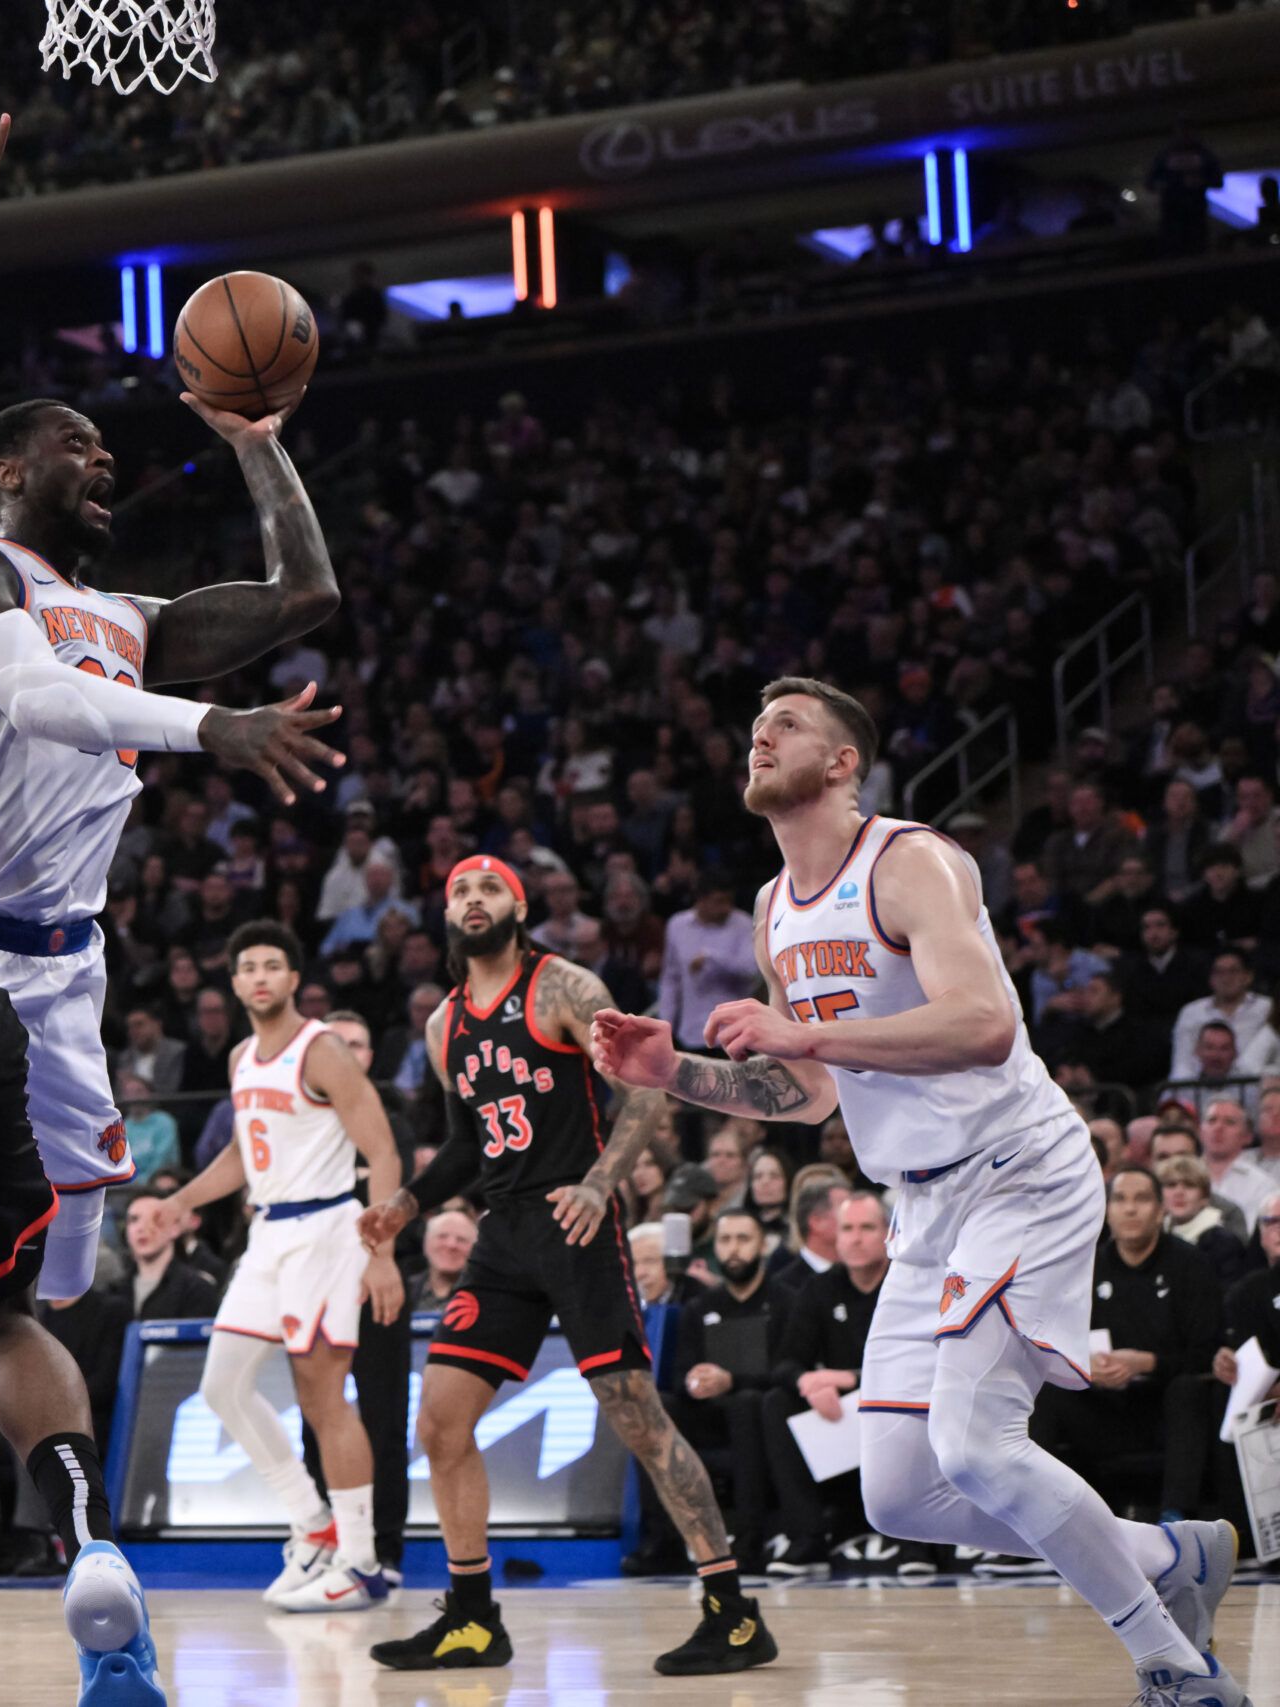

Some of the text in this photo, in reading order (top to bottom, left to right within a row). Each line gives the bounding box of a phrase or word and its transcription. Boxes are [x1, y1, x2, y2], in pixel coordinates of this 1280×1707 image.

[950, 50, 1193, 117] SUITE LEVEL
[665, 103, 876, 157] LEXUS
[41, 607, 99, 645] NEW
[799, 940, 877, 978] YORK
[249, 1119, 271, 1172] 6
[477, 1094, 534, 1159] 33
